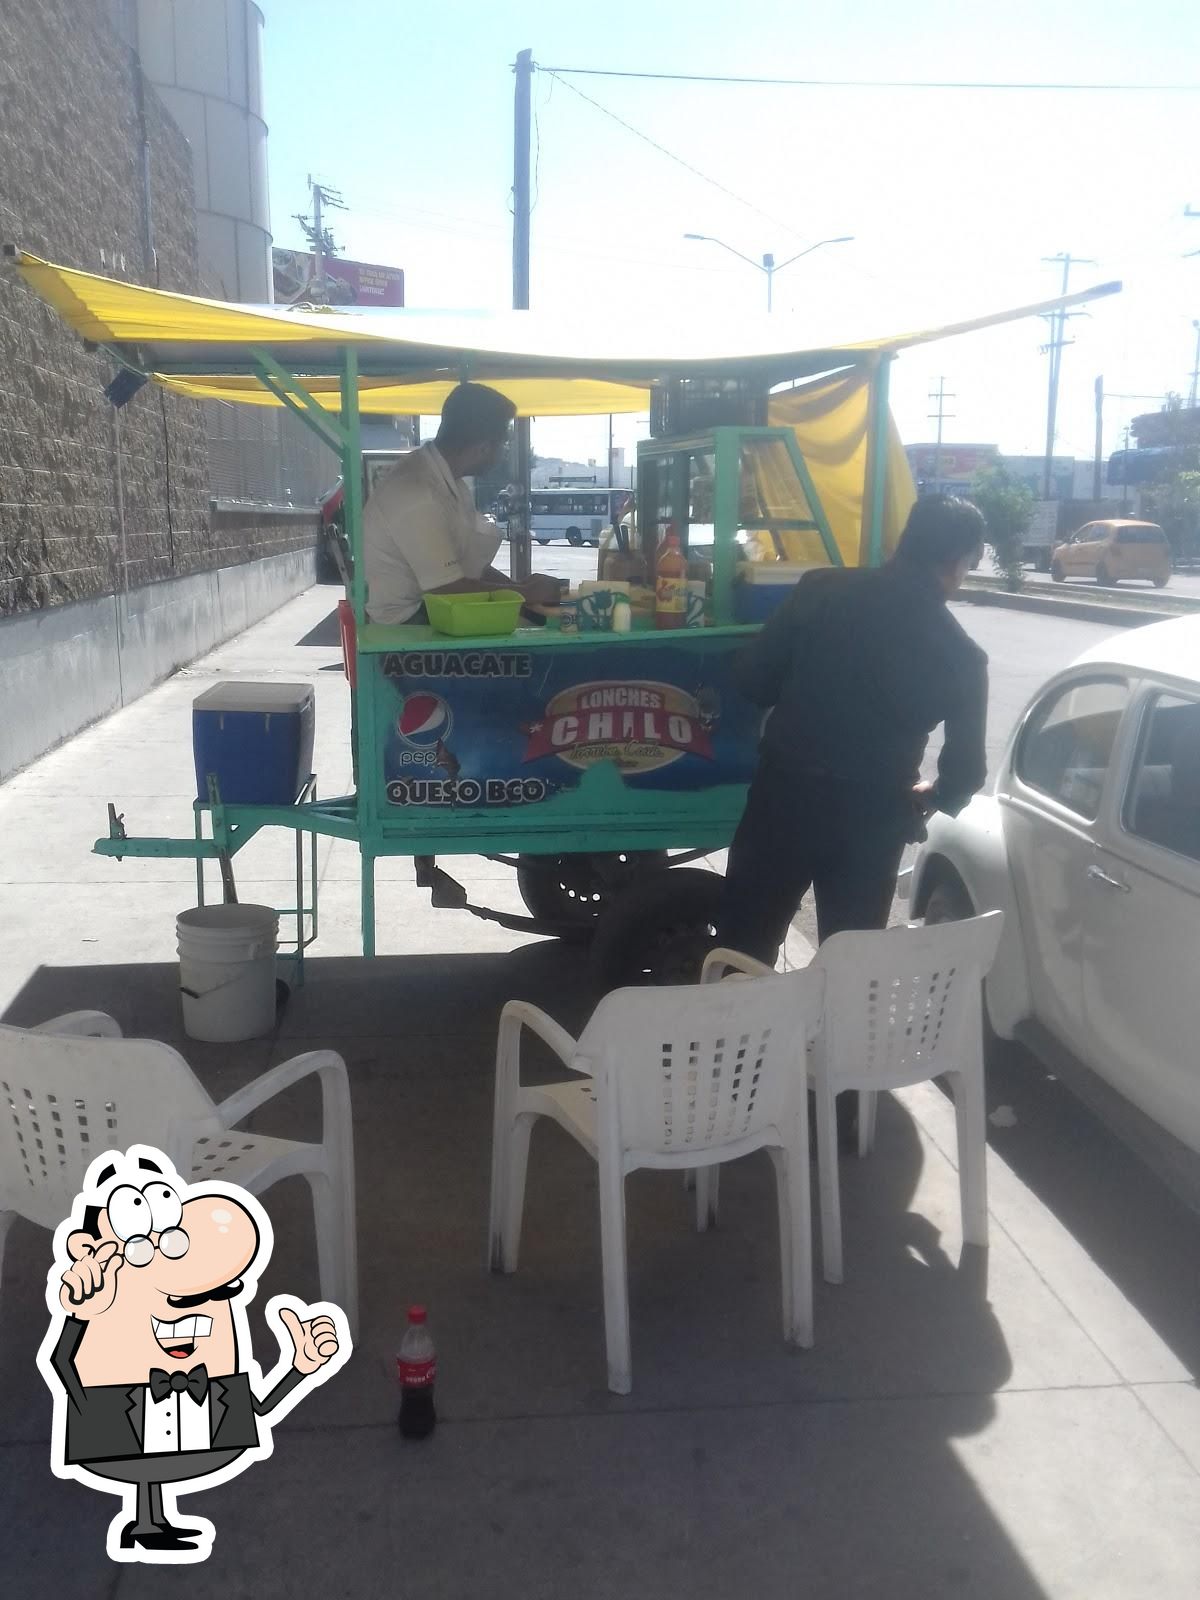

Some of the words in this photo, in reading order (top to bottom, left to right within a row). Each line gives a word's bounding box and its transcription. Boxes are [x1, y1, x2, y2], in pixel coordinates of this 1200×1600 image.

[384, 652, 531, 677] AGUACATE
[581, 687, 661, 708] LONCHES
[551, 712, 693, 746] CHILO
[400, 751, 449, 767] pep
[386, 778, 481, 806] QUESO
[486, 778, 546, 804] BCO
